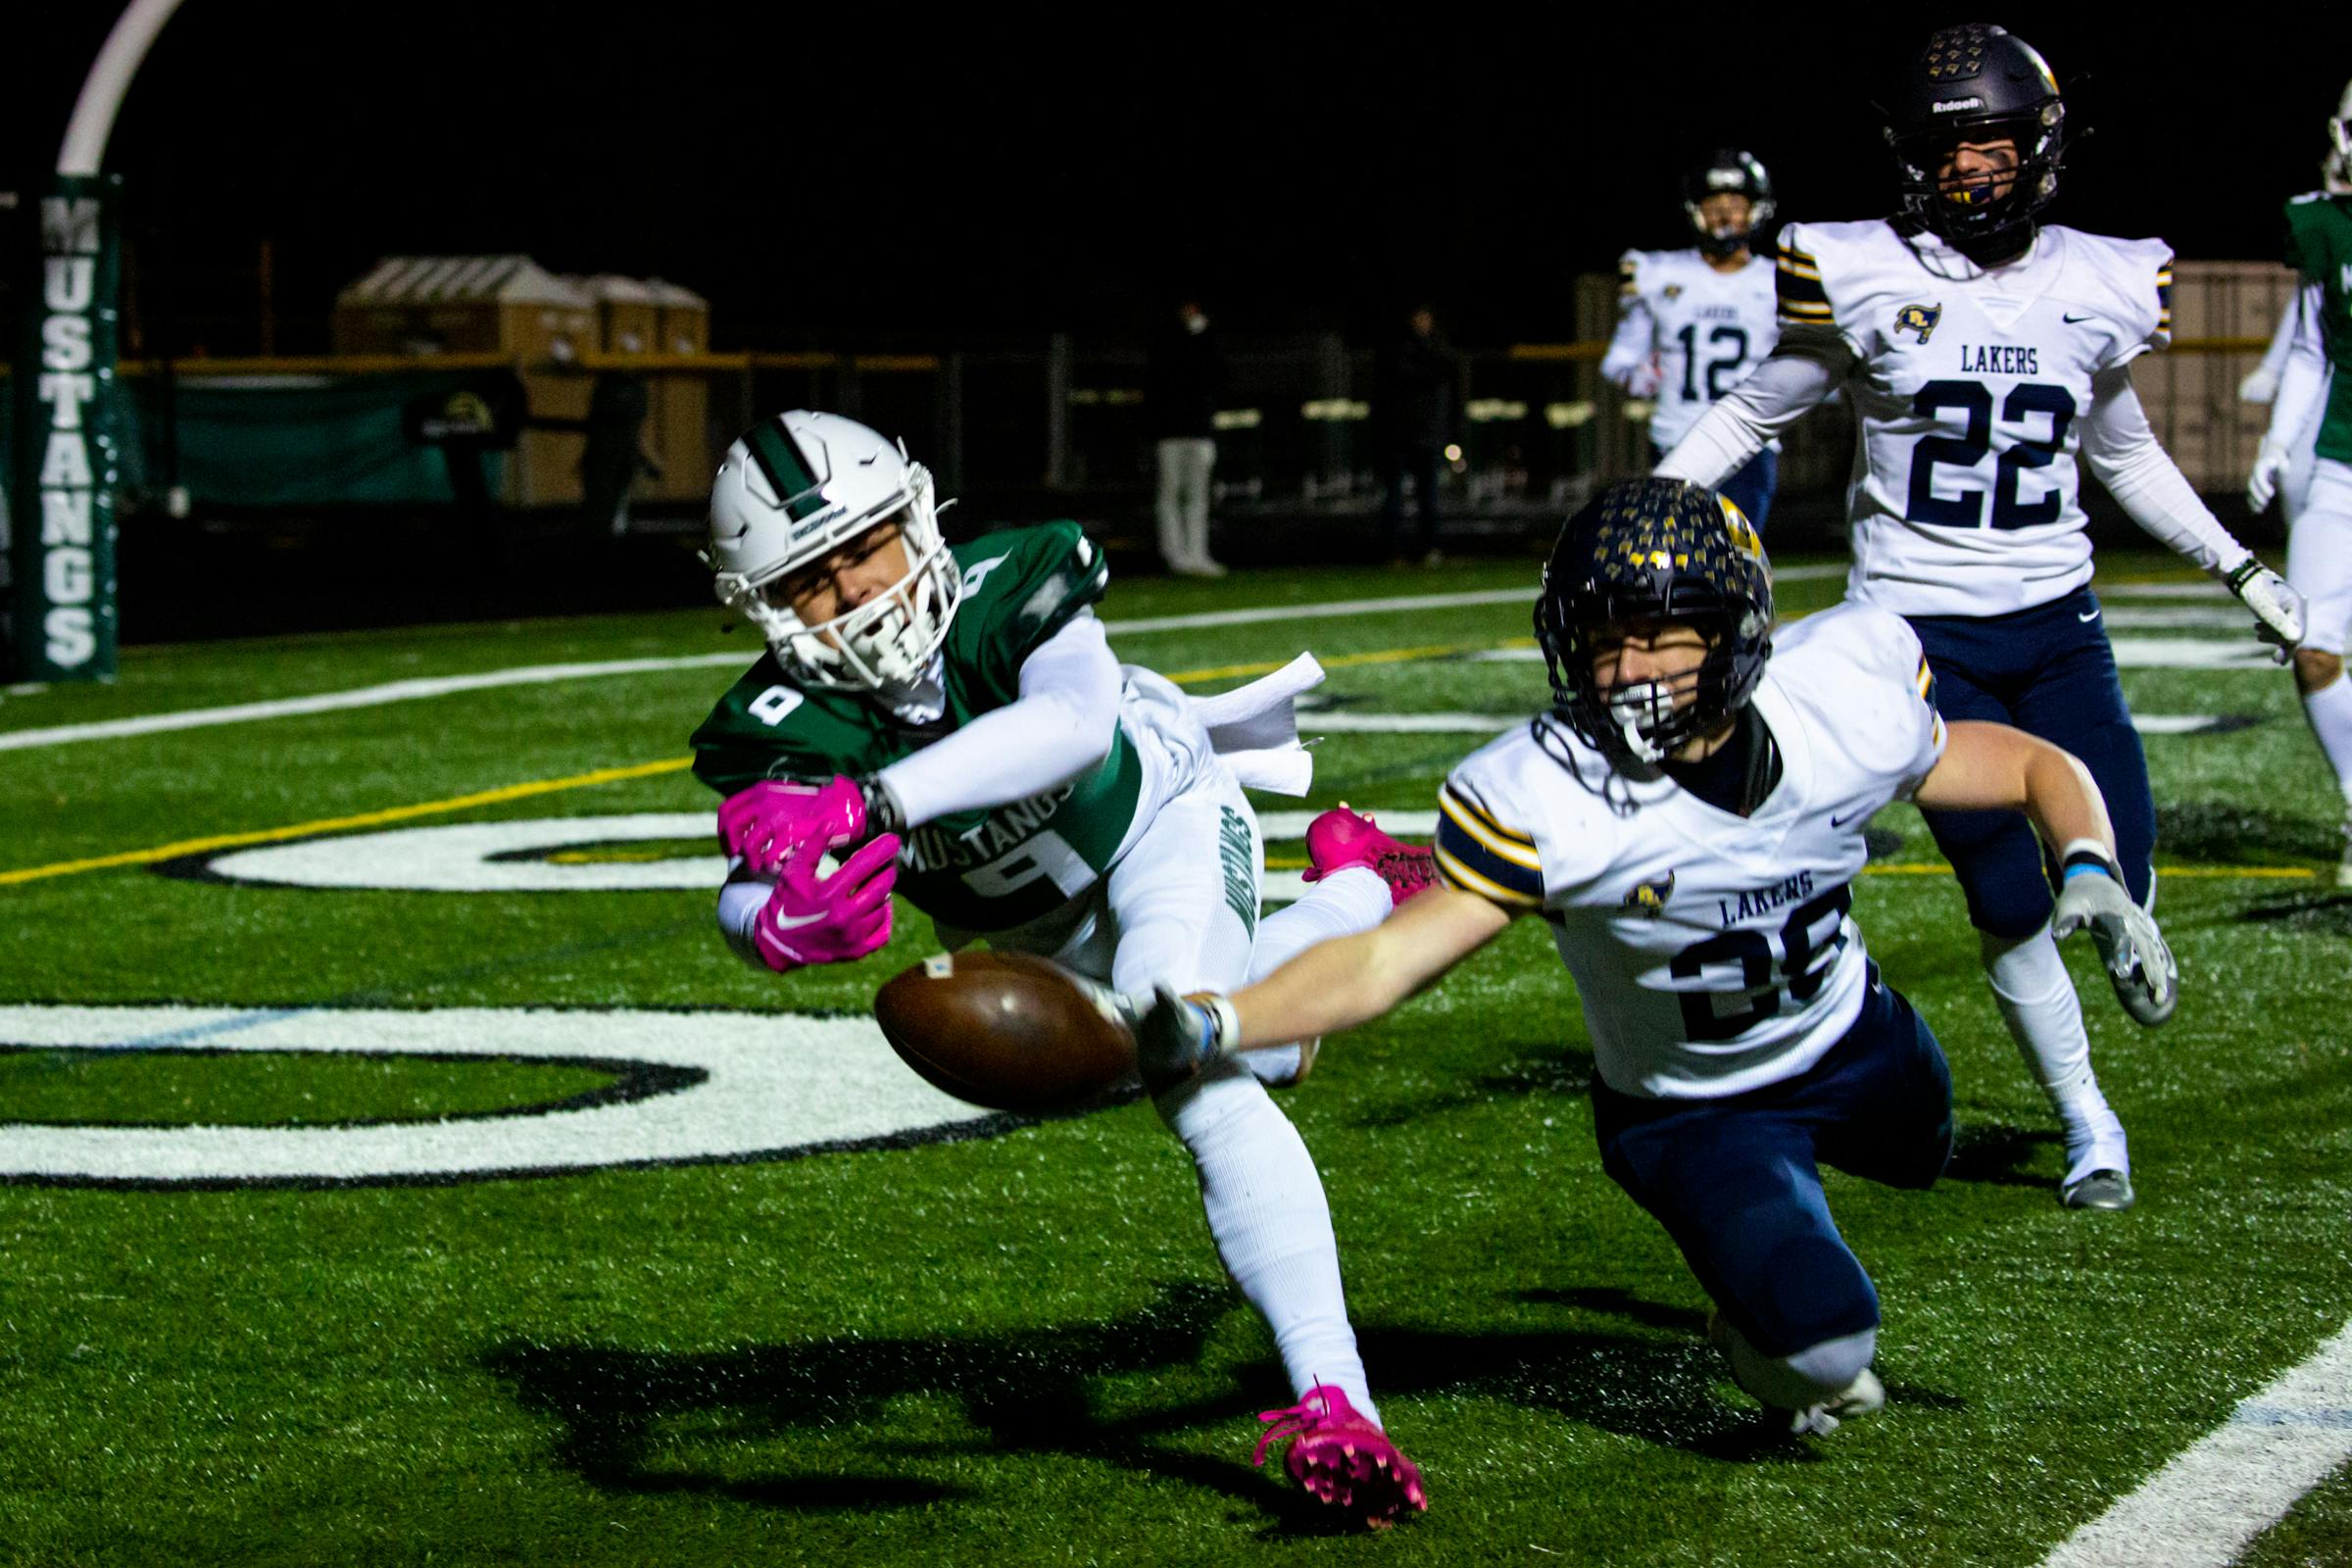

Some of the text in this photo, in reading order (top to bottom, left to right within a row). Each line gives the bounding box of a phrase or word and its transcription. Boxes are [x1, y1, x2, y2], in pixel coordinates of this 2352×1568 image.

[1678, 324, 1749, 401] 12
[1961, 346, 2037, 374] LAKERS
[39, 198, 98, 668] MUSTANGS
[1906, 380, 2076, 530] 22
[1718, 869, 1814, 929] LAKERS
